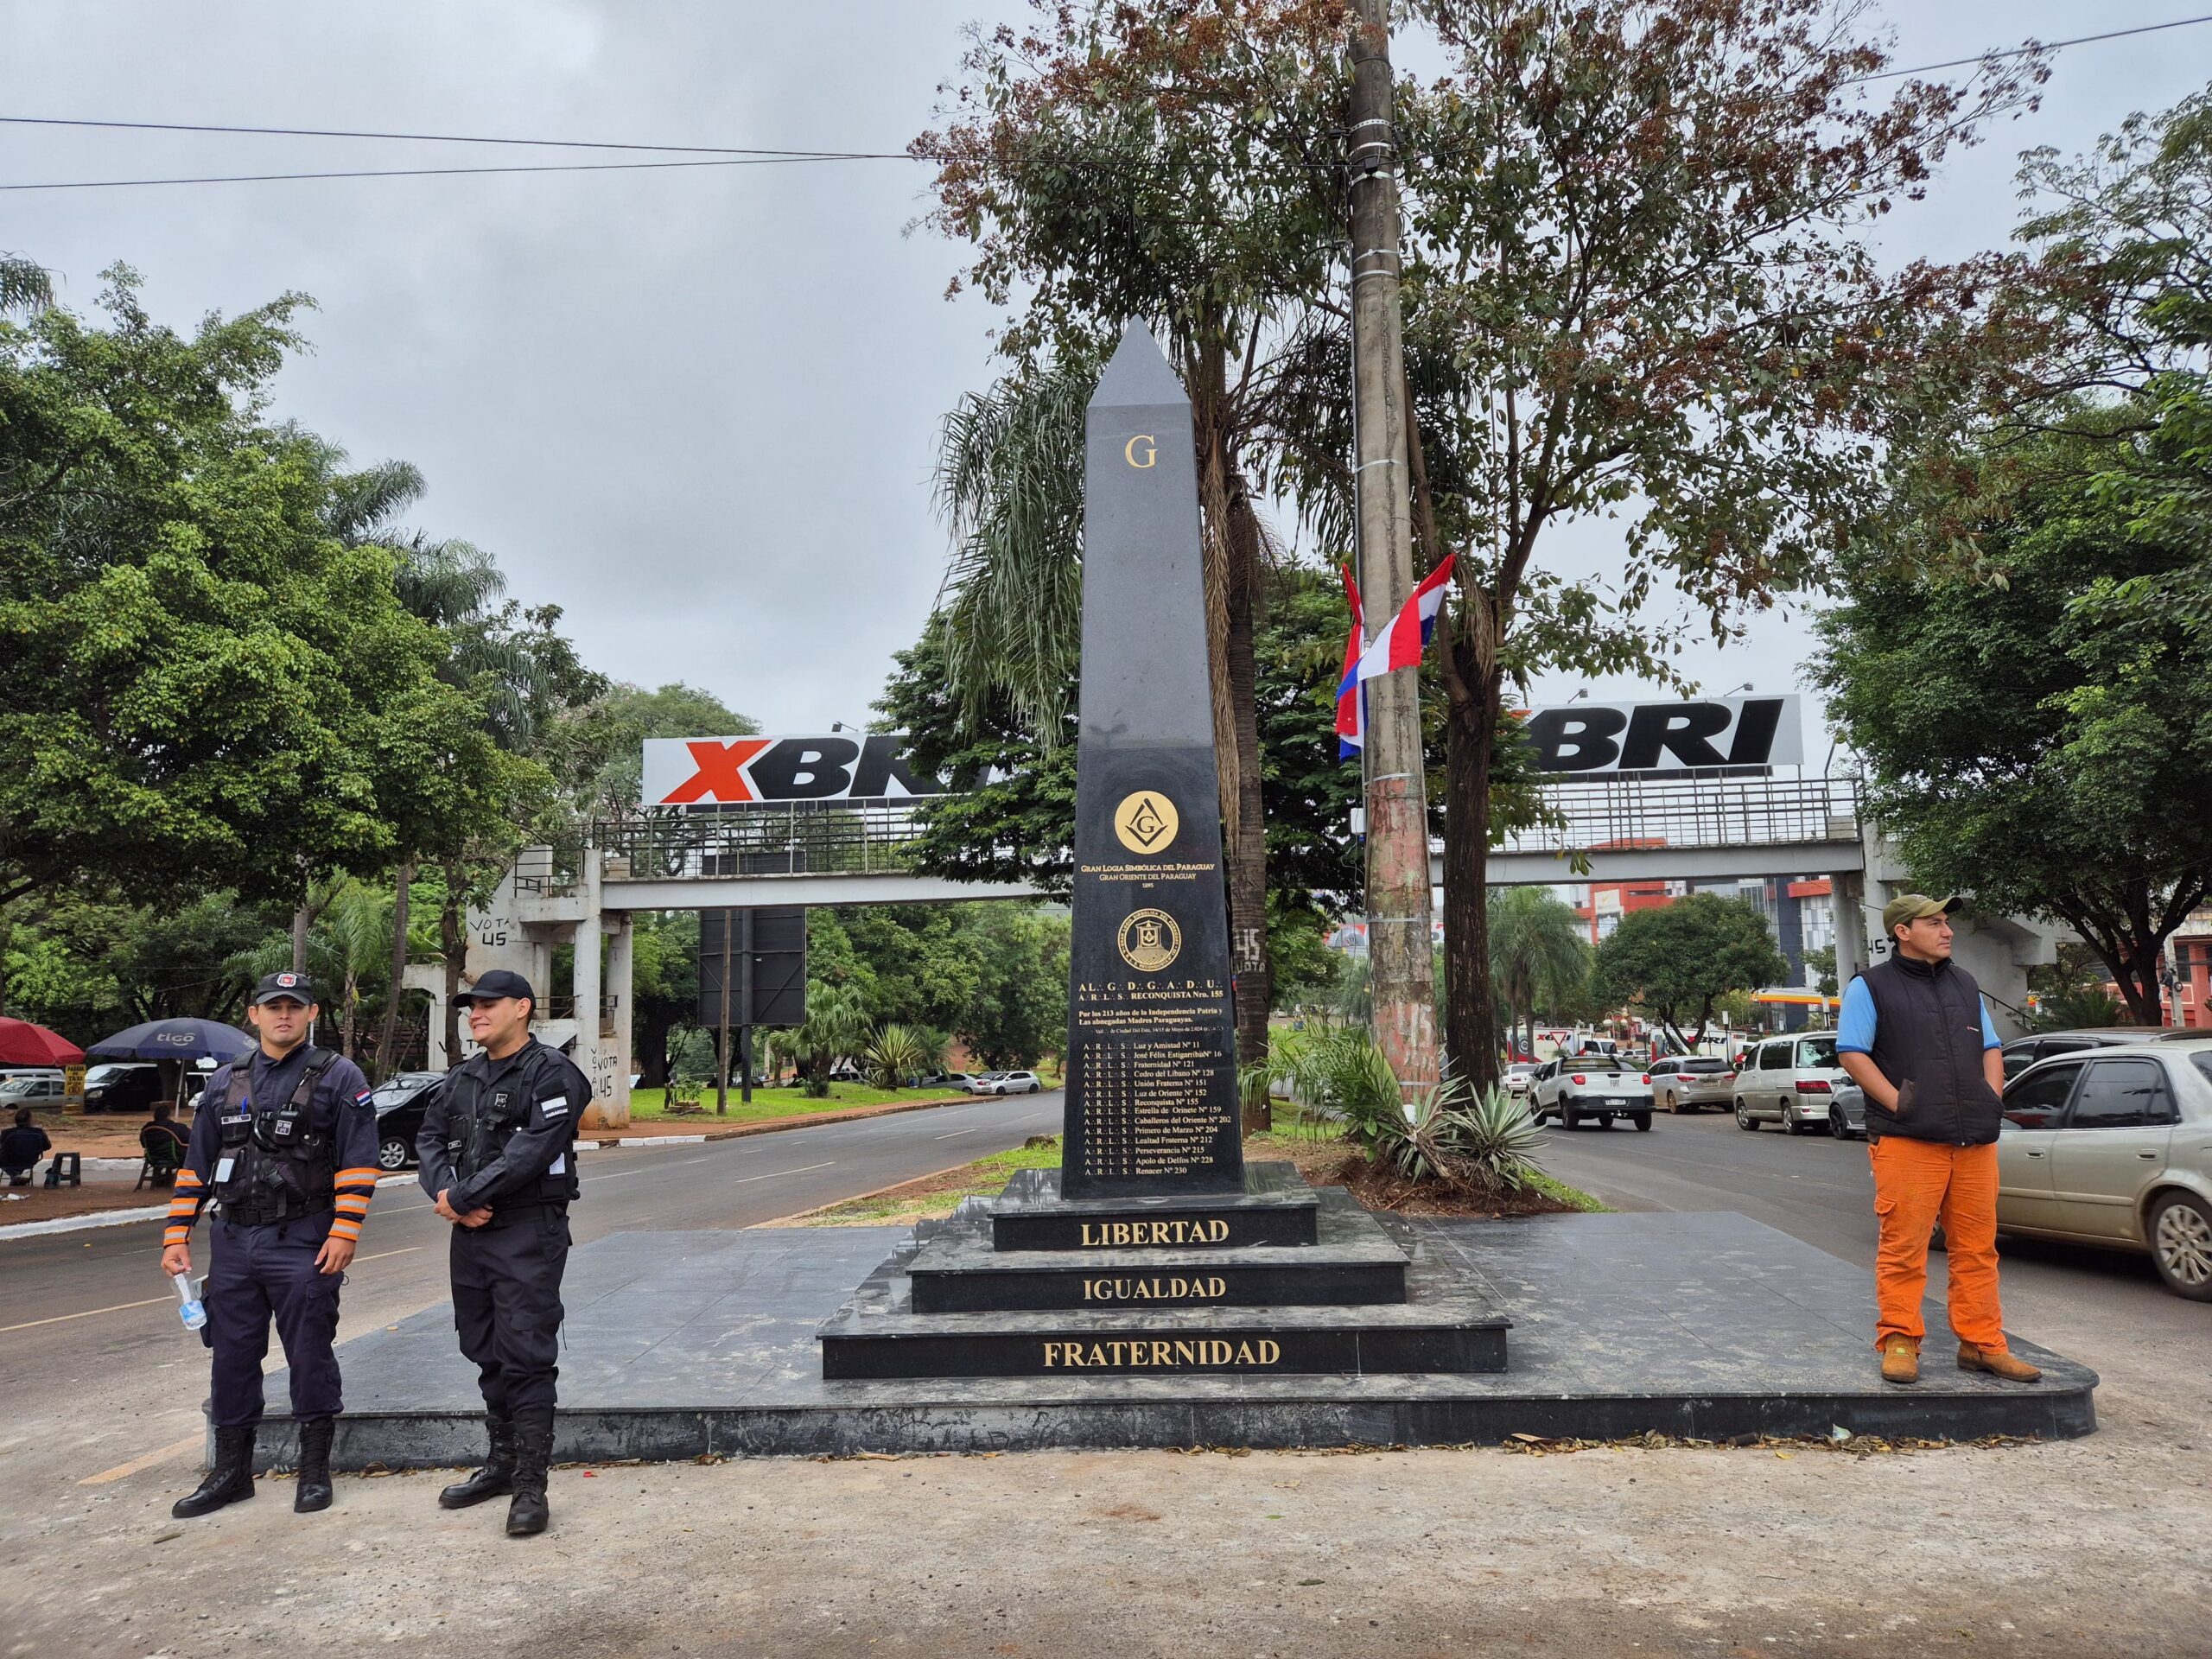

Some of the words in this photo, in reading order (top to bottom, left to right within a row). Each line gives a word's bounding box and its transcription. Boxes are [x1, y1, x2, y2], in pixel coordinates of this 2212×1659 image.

[1125, 435, 1158, 467] G
[1508, 699, 1783, 772] BRI
[1136, 816, 1155, 834] G
[482, 932, 507, 946] 45
[1233, 928, 1260, 961] 45
[598, 1056, 618, 1071] VOTA
[600, 1075, 612, 1098] 45
[1081, 1219, 1230, 1246] LIBERTAD
[1084, 1277, 1226, 1300] IGUALDAD
[1043, 1340, 1281, 1367] FRATERNIDAD
